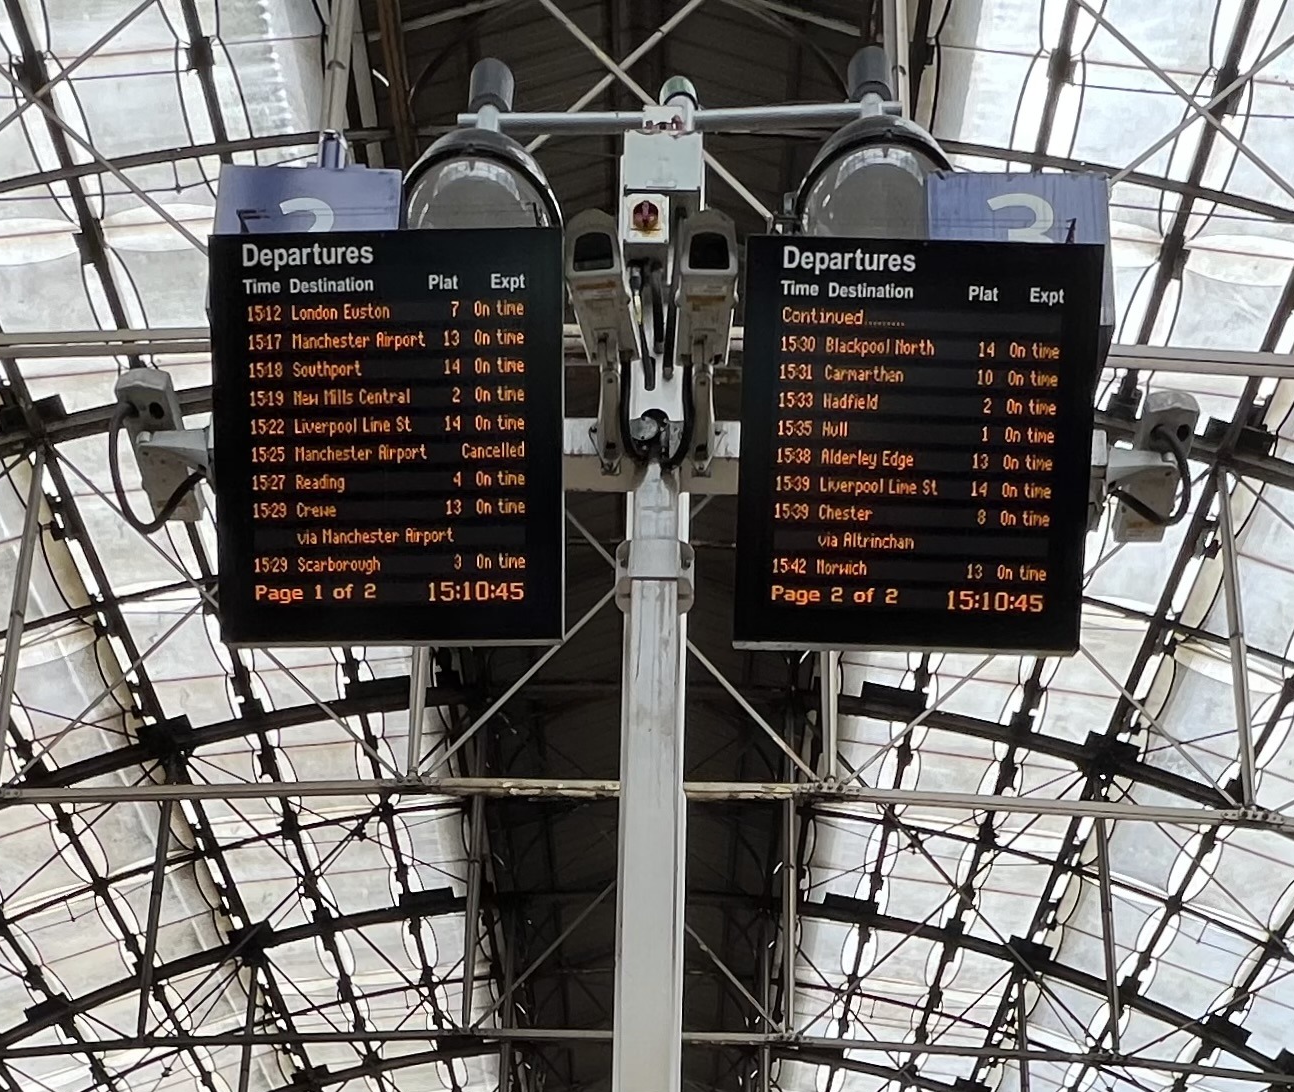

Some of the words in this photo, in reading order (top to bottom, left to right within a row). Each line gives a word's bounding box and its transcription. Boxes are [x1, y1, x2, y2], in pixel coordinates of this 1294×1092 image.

[242, 242, 374, 272] Departures
[783, 245, 916, 275] Departures
[242, 278, 281, 295] Time
[289, 276, 374, 294] Destination
[428, 274, 459, 290] Plat
[490, 273, 526, 293] Expt
[780, 279, 819, 297] Time
[828, 281, 914, 299] Destination
[968, 285, 999, 302] Plat
[1029, 287, 1065, 307] Expt
[247, 304, 282, 322] 15:12
[291, 304, 339, 321] London
[343, 302, 390, 320] Euston
[450, 300, 460, 318] 7
[474, 300, 491, 317] On
[496, 299, 524, 316] time
[248, 333, 282, 351] 15:17
[292, 332, 371, 350] Manchester
[376, 330, 426, 352] Airport
[443, 329, 460, 347] 13
[474, 328, 491, 346] On
[496, 328, 525, 345] time
[781, 335, 816, 353] 15:30
[825, 336, 891, 358] Blackpool
[894, 338, 935, 356] North
[978, 341, 995, 358] 14
[1009, 341, 1027, 358] On
[1031, 342, 1060, 360] time
[249, 361, 283, 379] 15:18
[292, 360, 362, 381] Southport
[444, 358, 461, 375] 14
[474, 357, 491, 374] On
[496, 356, 525, 373] time
[779, 363, 813, 380] 15:31
[824, 364, 904, 383] Carmarthen
[977, 369, 994, 386] 10
[1007, 369, 1025, 387] On
[1029, 370, 1059, 387] time
[249, 390, 284, 407] 15:19
[293, 390, 319, 406] New
[323, 389, 354, 405] Mills
[358, 388, 411, 405] Central
[452, 386, 461, 403] 2
[474, 386, 492, 403] On
[496, 385, 525, 402] time
[778, 391, 814, 409] 15:33
[823, 392, 879, 410] Hadfield
[983, 397, 992, 414] 2
[1006, 398, 1023, 415] On
[1028, 398, 1057, 416] time
[250, 418, 285, 435] 15:22
[294, 417, 357, 438] Liverpool
[395, 415, 413, 433] St
[444, 415, 461, 432] 14
[474, 414, 492, 432] On
[496, 414, 525, 431] time
[777, 419, 813, 437] 15:35
[821, 421, 848, 438] Hull
[981, 426, 989, 442] 1
[1004, 426, 1022, 443] On
[1026, 427, 1055, 444] time
[251, 446, 286, 463] 15:25
[294, 445, 373, 462] Manchester
[378, 443, 428, 464] Airport
[461, 440, 525, 459] Cancelled
[776, 447, 812, 465] 15:38
[821, 447, 878, 470] Alderley
[882, 450, 914, 471] Edge
[972, 452, 989, 470] 13
[1002, 454, 1020, 471] On
[1024, 454, 1053, 471] time
[252, 474, 286, 491] 15:27
[295, 473, 346, 493] Reading
[453, 471, 462, 487] 4
[475, 470, 492, 487] On
[496, 470, 525, 486] time
[776, 475, 811, 492] 15:39
[819, 476, 884, 497] Liverpool
[922, 479, 938, 496] St
[970, 480, 988, 497] 14
[1001, 482, 1018, 498] On
[1023, 482, 1052, 499] time
[253, 502, 287, 519] 15:29
[296, 502, 337, 518] Crewe
[446, 499, 462, 515] 13
[475, 498, 493, 515] On
[497, 498, 526, 514] time
[774, 502, 810, 520] 15:39
[818, 503, 874, 522] Chester
[977, 508, 987, 525] 8
[1000, 510, 1017, 527] On
[1022, 510, 1050, 527] time
[296, 528, 318, 545] via
[322, 527, 400, 545] Manchester
[405, 527, 455, 547] Airport
[817, 531, 839, 548] via
[254, 556, 288, 573] 15:29
[297, 555, 381, 576] Scarborough
[476, 553, 492, 570] On
[498, 552, 526, 569] time
[772, 557, 807, 575] 15:42
[816, 558, 868, 576] Norwich
[967, 563, 983, 580] 13
[996, 564, 1013, 581] On
[1019, 565, 1047, 582] time
[255, 584, 304, 604] Page
[314, 584, 323, 600] 1
[332, 583, 354, 600] of
[364, 583, 377, 599] 2
[428, 580, 525, 602] 15:10:45
[771, 584, 821, 606] Page
[830, 586, 844, 603] 2
[853, 587, 876, 603] of
[885, 588, 899, 604] 2
[947, 590, 1044, 613] 15:10:45
